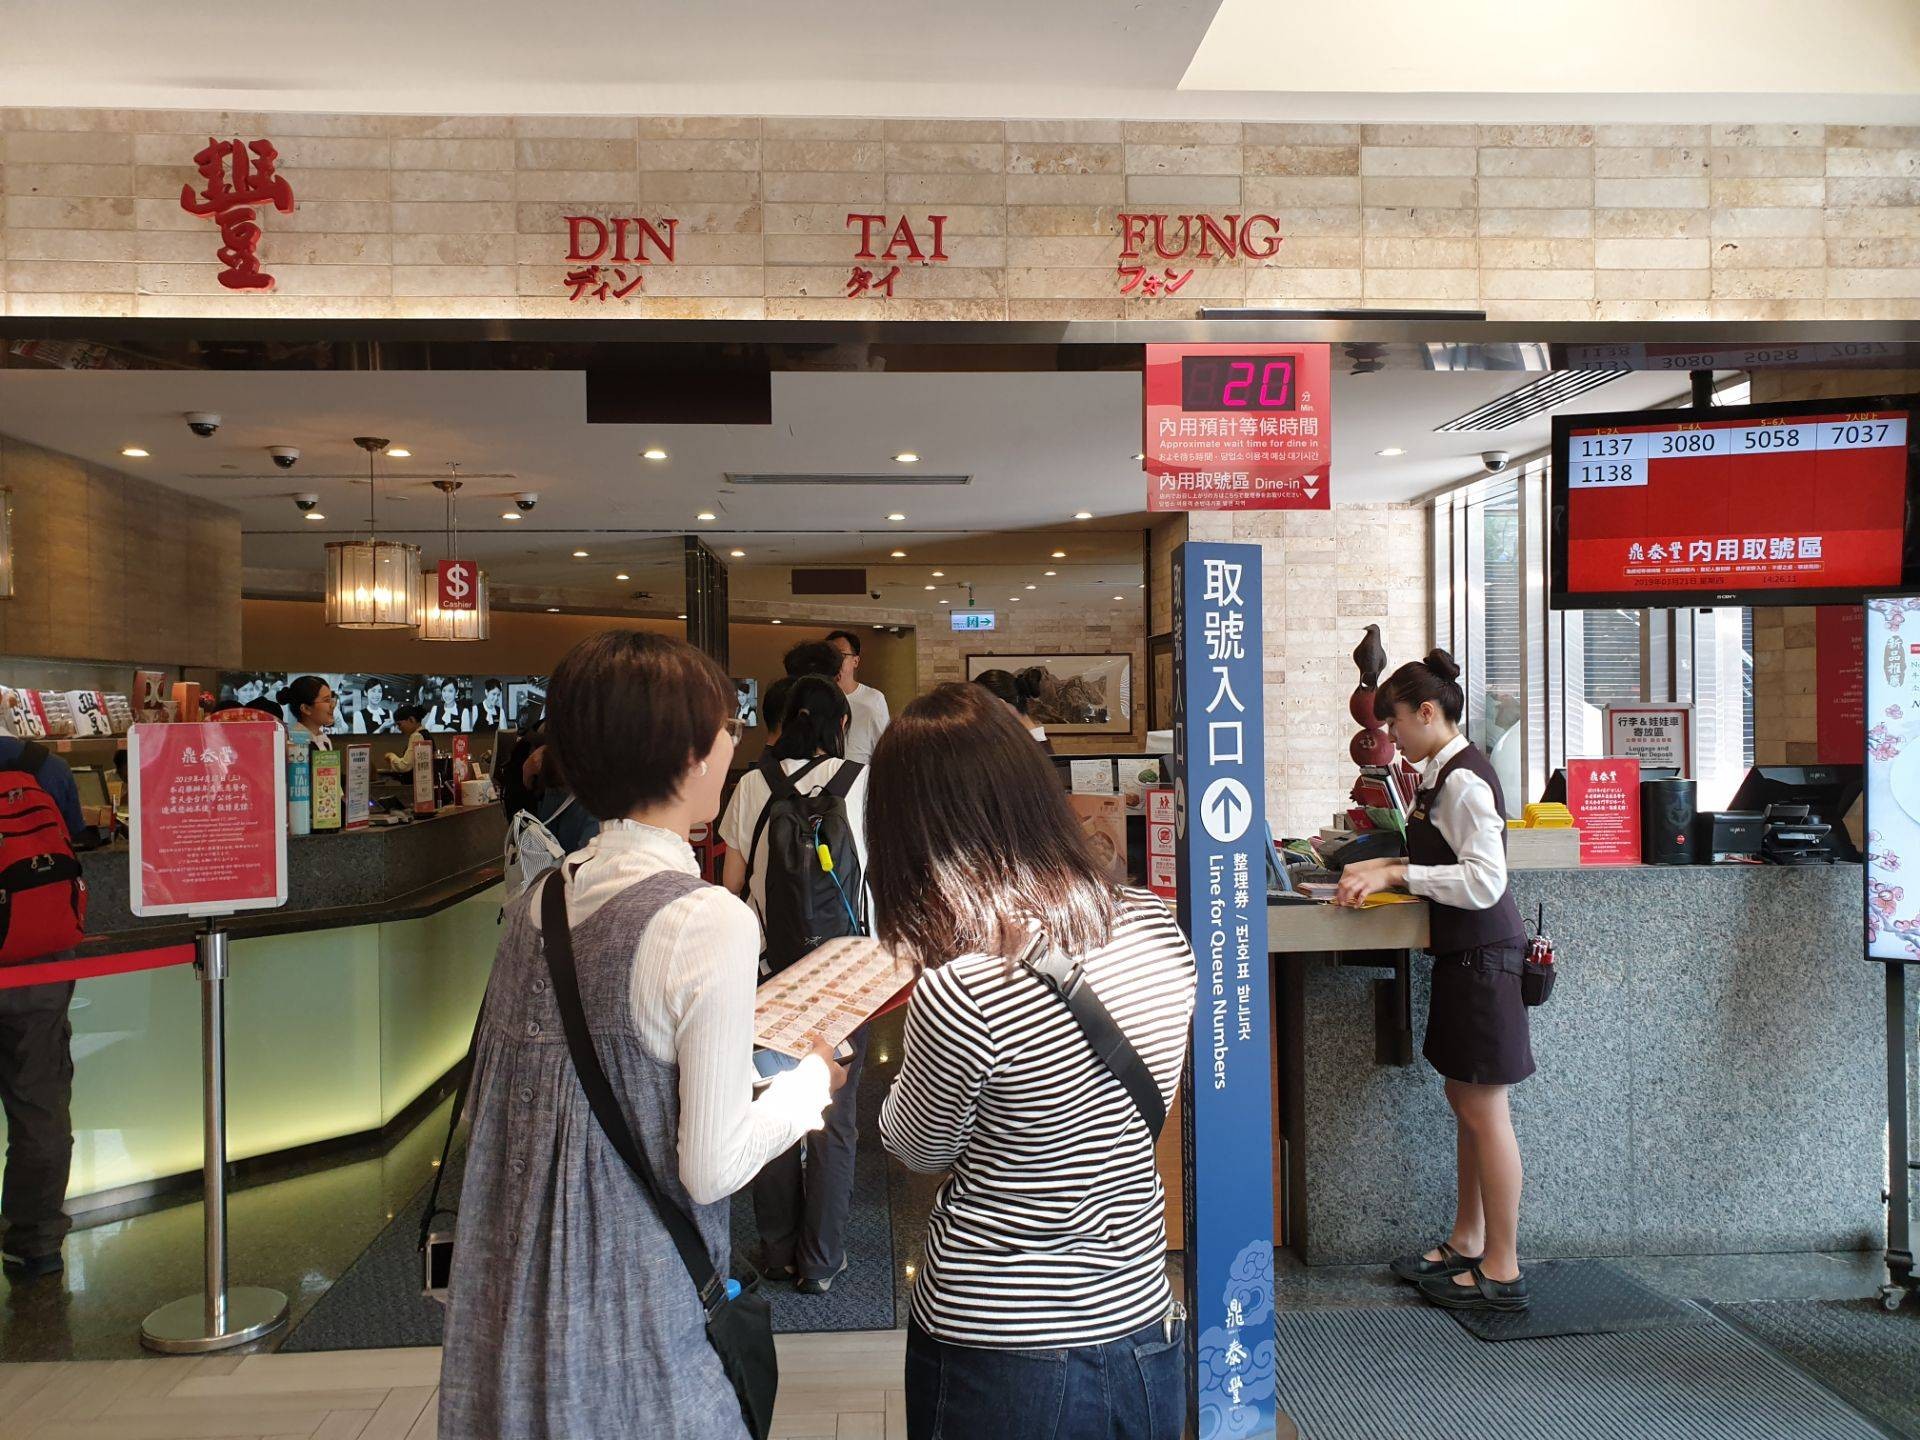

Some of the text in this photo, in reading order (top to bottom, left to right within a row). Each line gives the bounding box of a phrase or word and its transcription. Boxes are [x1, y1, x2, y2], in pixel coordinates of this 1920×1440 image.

[563, 213, 1284, 264] DIN TAI FUNG
[563, 264, 1195, 302] ディン タイ フォン
[1222, 362, 1292, 407] 20
[1160, 439, 1318, 449] Approximate wait time for dine in
[1661, 433, 1715, 454] 3080
[1745, 429, 1800, 449] 5058
[1831, 424, 1889, 445] 7037
[1582, 438, 1633, 457] 1137
[1255, 477, 1300, 490] Dine-in
[1581, 464, 1633, 483] 1138
[443, 600, 472, 608] Cashier
[1202, 558, 1246, 767] 取號入口
[1633, 727, 1665, 737] 寄放區
[1209, 854, 1229, 1090] Line for Queue Numbers
[1225, 1298, 1247, 1404] 鼎泰豐
